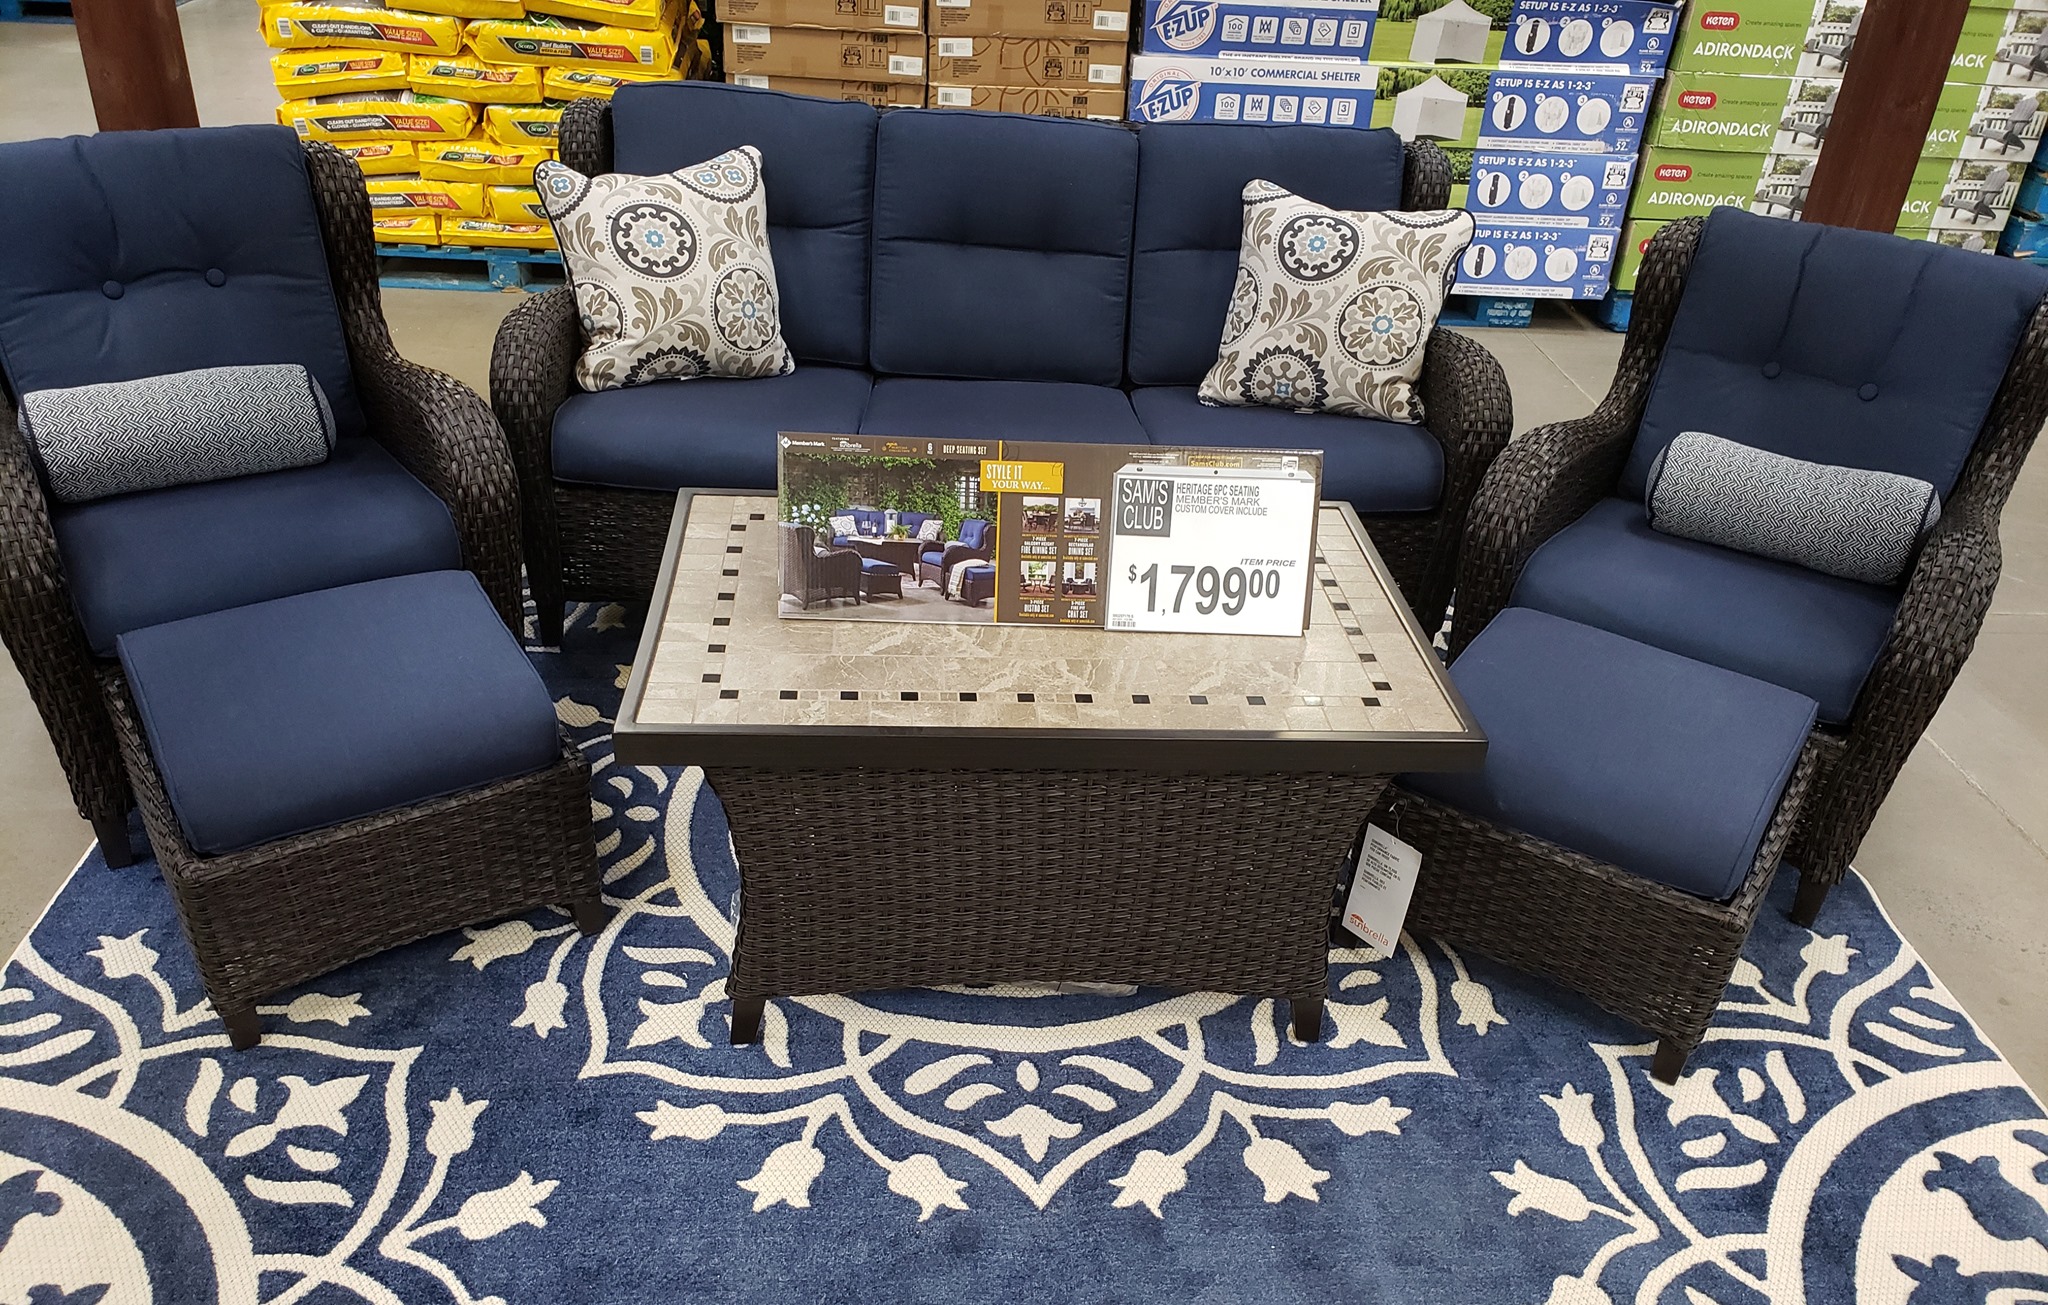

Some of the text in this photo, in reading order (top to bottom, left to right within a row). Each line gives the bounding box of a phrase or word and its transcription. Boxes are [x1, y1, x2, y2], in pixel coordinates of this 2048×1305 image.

[1520, 1, 1548, 10] SETUP
[1550, 2, 1559, 11] IS
[1561, 3, 1576, 12] E-Z
[1578, 3, 1590, 12] AS
[1705, 16, 1735, 26] KETER
[384, 27, 405, 36] VALUE
[1228, 22, 1243, 31] 100
[587, 47, 608, 55] VALUE
[1693, 41, 1796, 59] ADIRONDACK
[1640, 63, 1651, 72] 52
[1251, 68, 1318, 80] COMMERCIAL
[1321, 71, 1360, 82] SHELTER
[1495, 78, 1522, 87] SETUP
[1525, 79, 1533, 88] IS
[1535, 80, 1551, 88] E-Z
[1552, 80, 1564, 89] AS
[1683, 95, 1711, 105] KETER
[394, 118, 414, 126] VALUE
[1671, 119, 1772, 137] ADIRONDACK
[1615, 141, 1627, 151] 52
[1478, 156, 1506, 165] SETUP
[1508, 157, 1516, 166] IS
[1518, 157, 1533, 166] E-Z
[1535, 158, 1547, 167] AS
[1660, 168, 1687, 178] KETER
[1648, 191, 1746, 208] ADIRONDACK
[1475, 229, 1492, 238] TUP
[1493, 230, 1501, 239] IS
[1504, 230, 1518, 239] E-Z
[1520, 231, 1532, 240] AS
[1583, 287, 1594, 296] 52
[943, 445, 987, 455] DEEP SEATING SET
[986, 464, 1023, 480] STYLE IT
[992, 480, 1019, 489] YOUR
[1122, 479, 1169, 505] SAM'S
[1176, 483, 1260, 497] HERITAGE 6PC SEATING
[1176, 495, 1260, 506] MEMBER'S MARK
[1175, 504, 1268, 516] CUSTOM COVER INCLUDE
[1123, 505, 1164, 530] CLUB
[1049, 546, 1057, 555] SET
[1085, 548, 1094, 556] SET
[1240, 558, 1296, 567] ITEM PRICE
[1041, 605, 1049, 613] SET
[1080, 610, 1088, 618] SET
[1349, 917, 1389, 946] sunbrella
